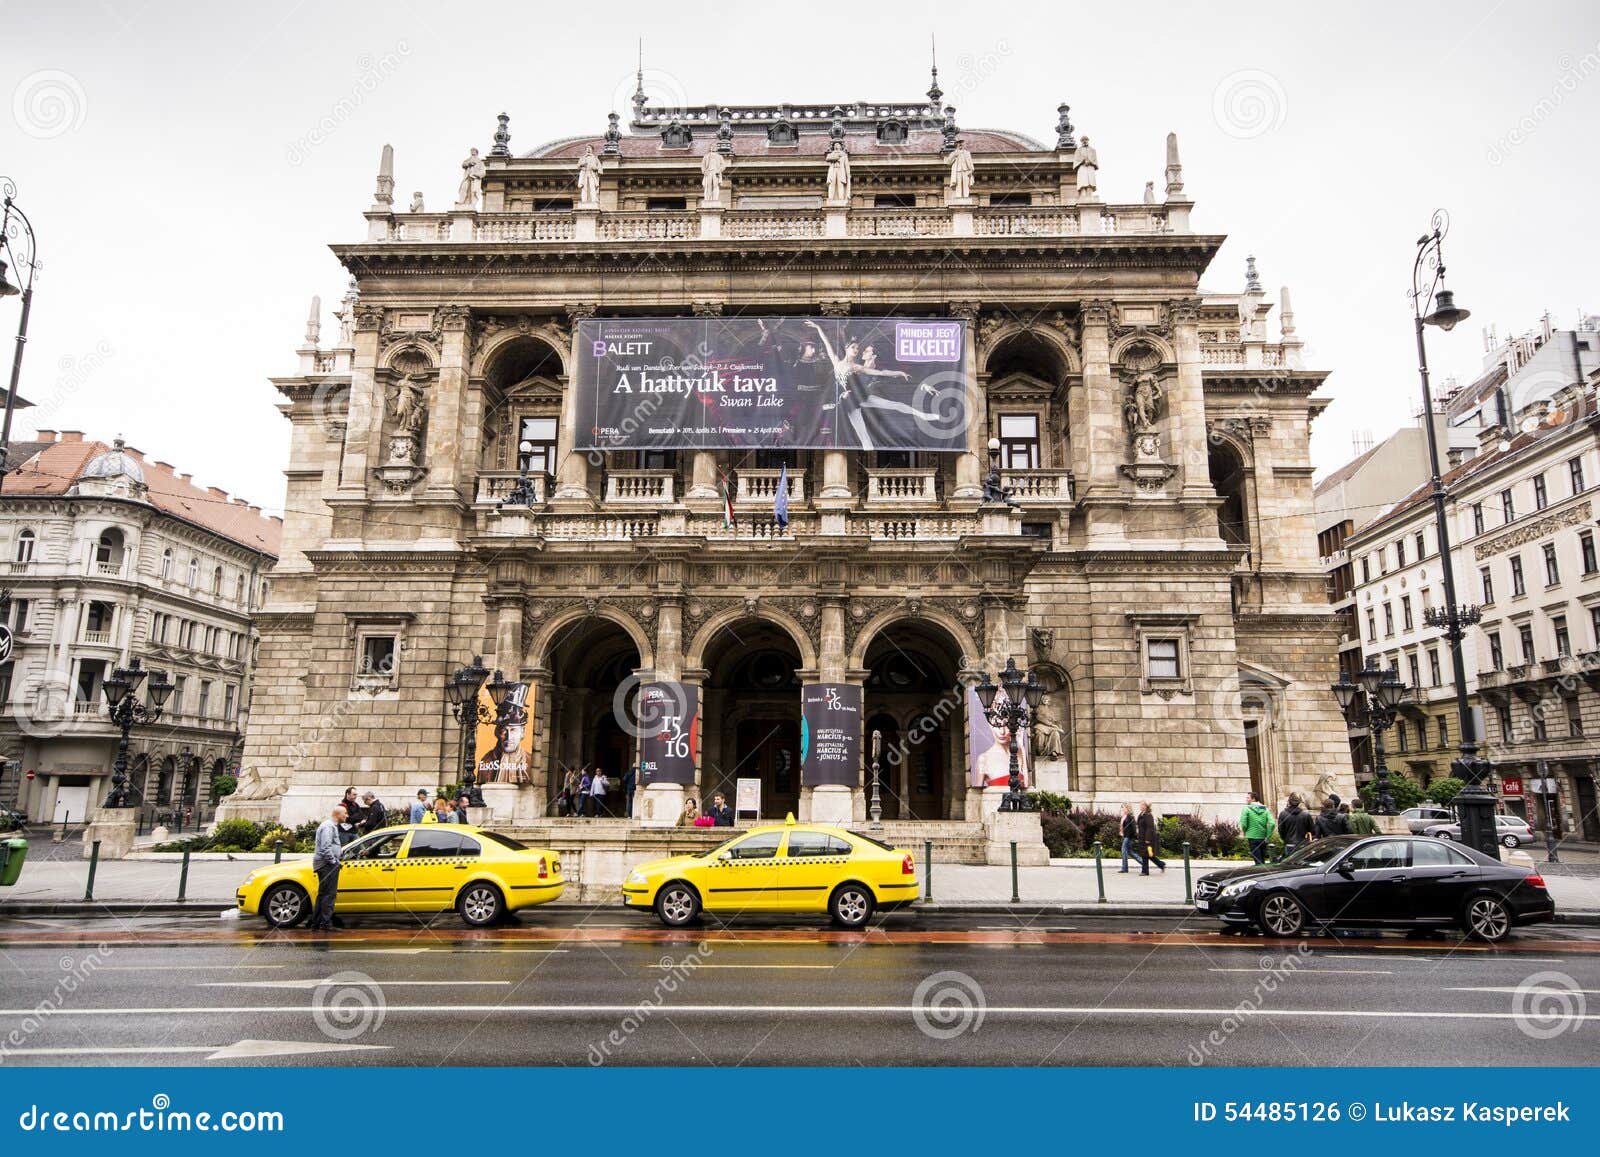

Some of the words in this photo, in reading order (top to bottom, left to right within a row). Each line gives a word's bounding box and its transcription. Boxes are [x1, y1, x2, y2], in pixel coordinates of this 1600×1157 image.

[900, 328, 934, 338] MINDEN
[935, 328, 955, 338] JEGY
[593, 341, 653, 357] BALETT
[900, 340, 956, 357] ELKELT!
[613, 373, 633, 394] A
[640, 371, 727, 399] hattyúk
[733, 374, 777, 393] tava
[719, 395, 752, 407] Swan
[755, 395, 784, 407] Lake
[661, 715, 681, 741] 15
[665, 732, 689, 758] 16
[1505, 781, 1519, 791] café
